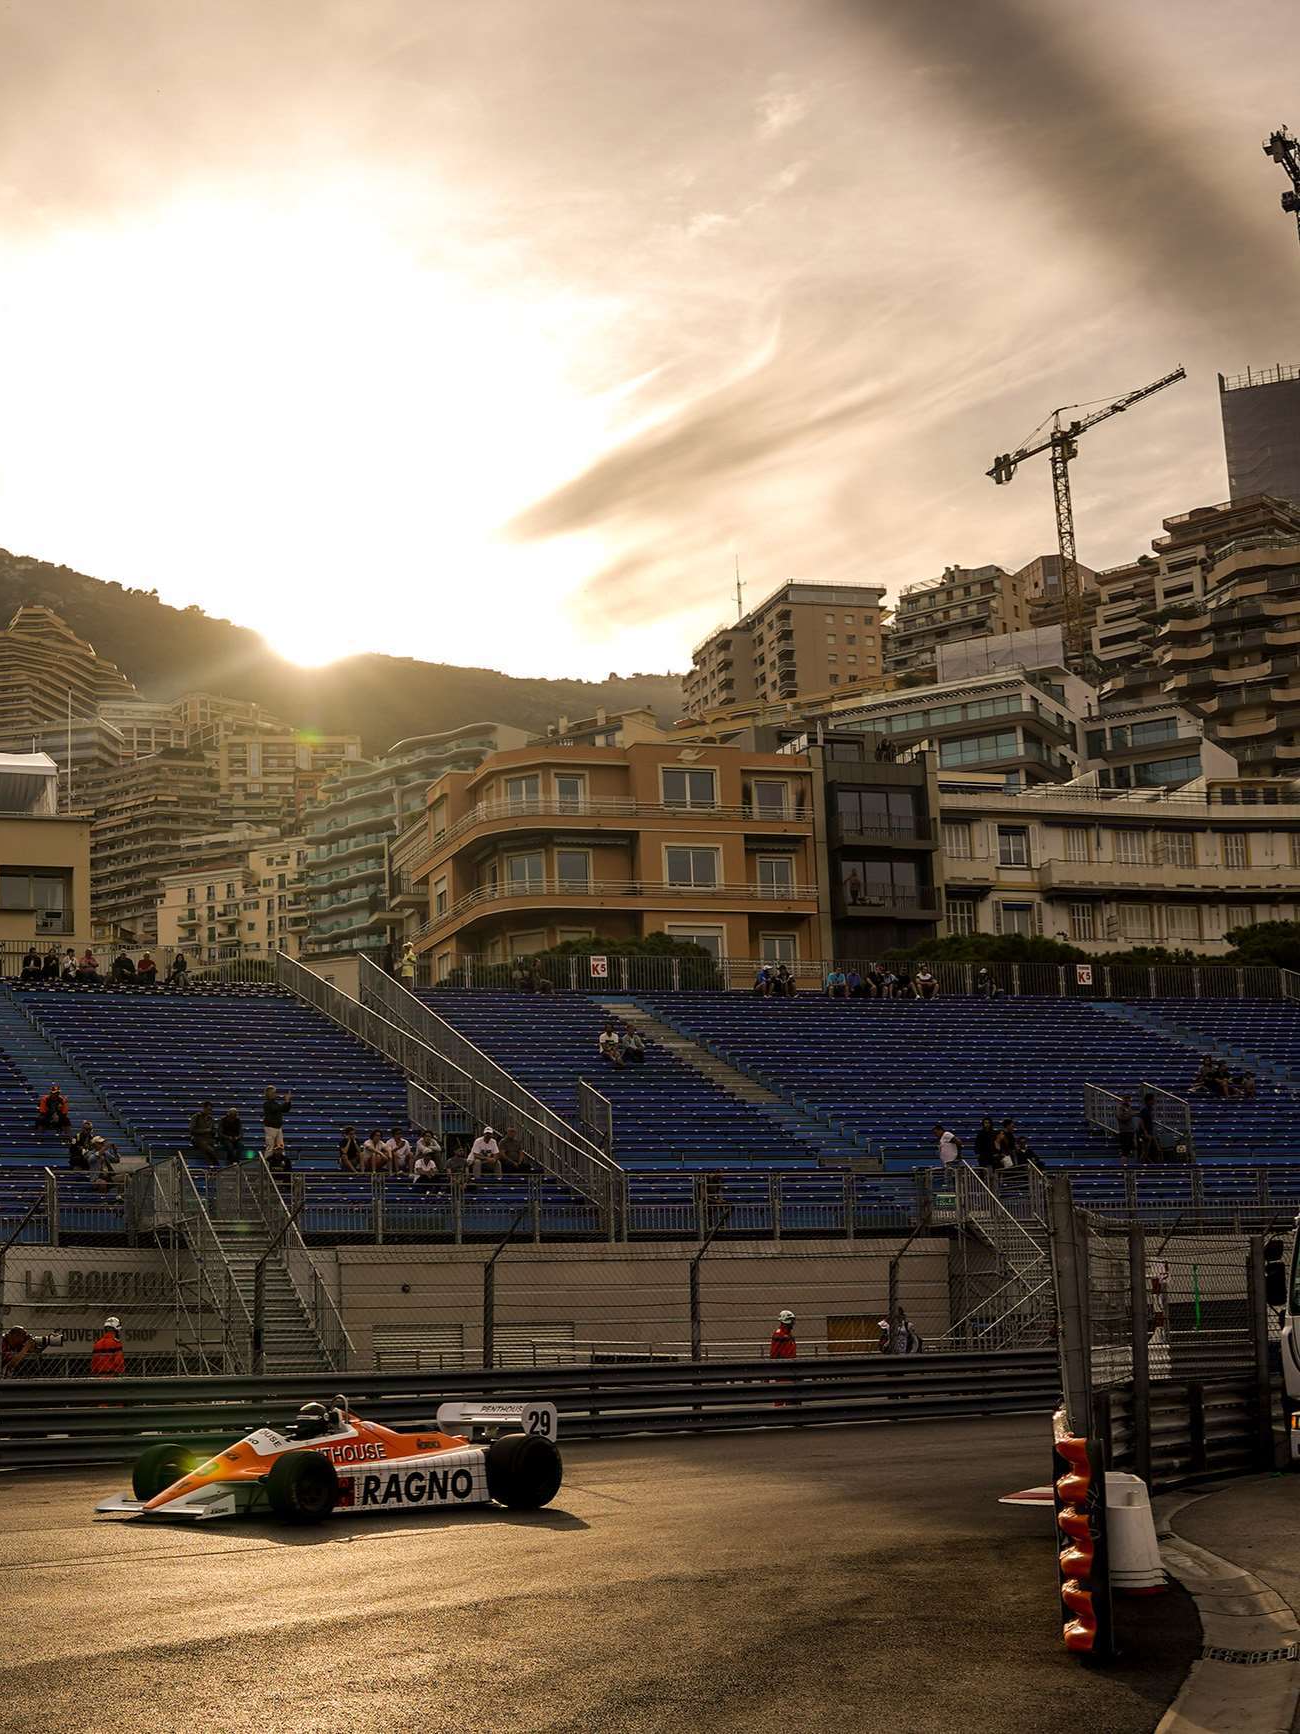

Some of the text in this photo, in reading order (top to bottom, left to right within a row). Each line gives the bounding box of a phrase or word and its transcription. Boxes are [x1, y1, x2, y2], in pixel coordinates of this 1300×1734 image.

[592, 963, 606, 976] K5
[1078, 972, 1091, 984] K5
[25, 1270, 57, 1298] LA
[125, 1329, 157, 1342] SHOP
[481, 1404, 524, 1414] PENTHOUS
[528, 1410, 551, 1436] 29
[316, 1442, 387, 1464] THOUSE
[362, 1468, 473, 1506] RAGNO
